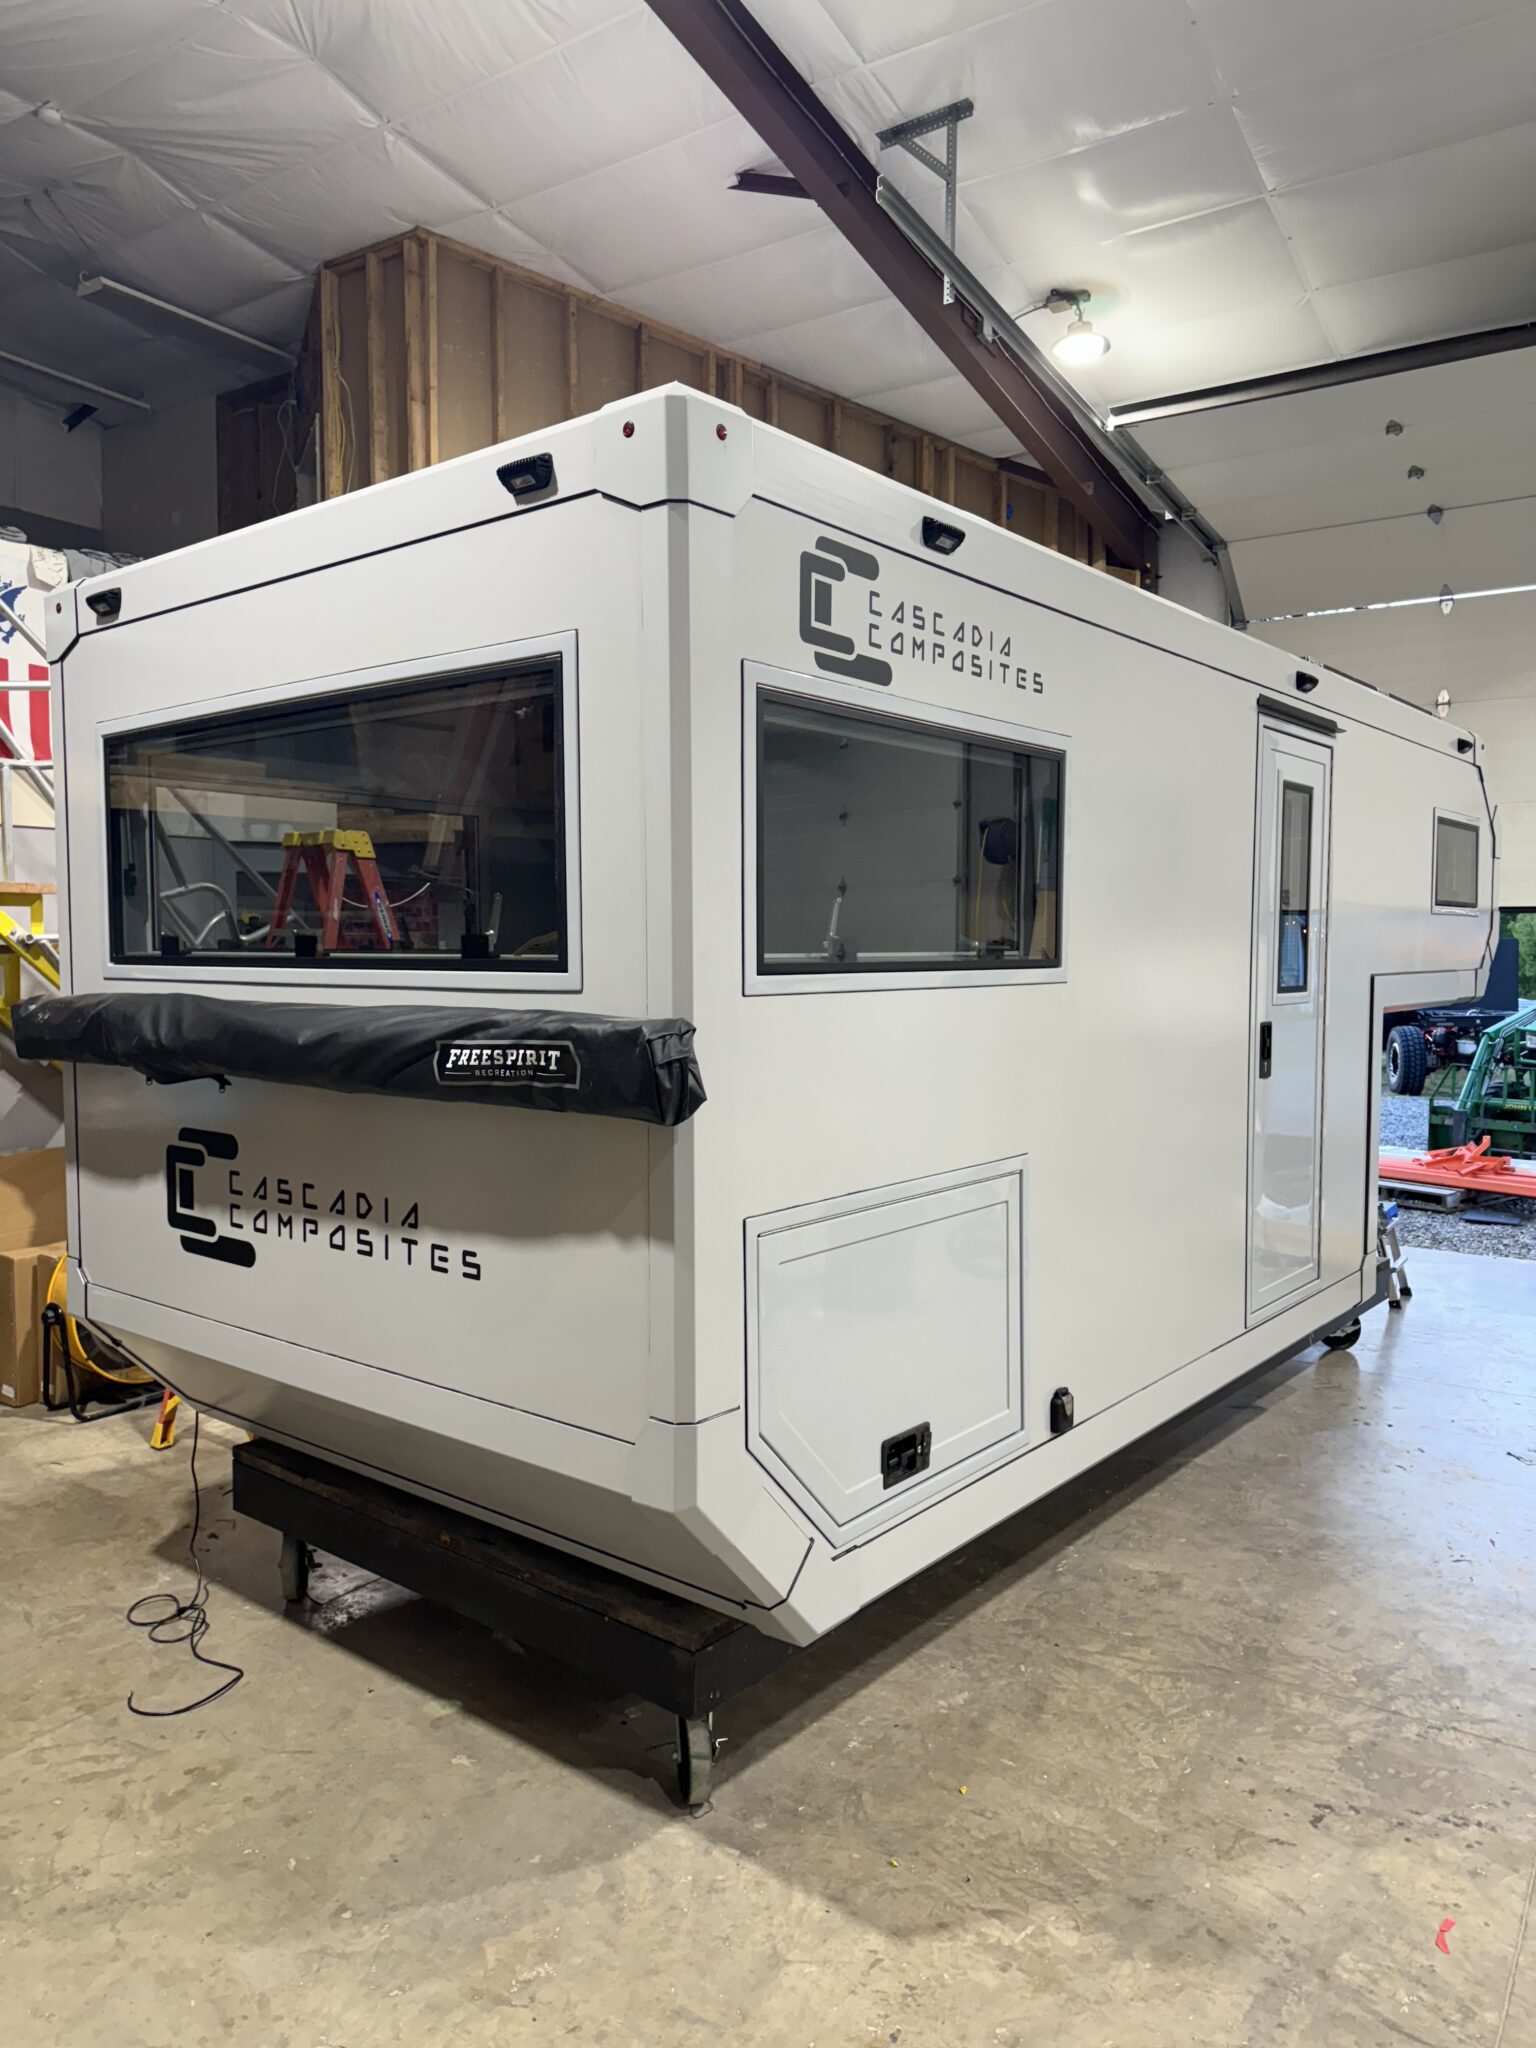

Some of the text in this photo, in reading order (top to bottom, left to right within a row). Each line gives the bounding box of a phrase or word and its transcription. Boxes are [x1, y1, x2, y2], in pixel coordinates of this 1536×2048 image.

[868, 589, 1011, 659] CASCADIA
[868, 623, 1044, 695] COMPOSITES
[445, 1048, 561, 1071] FREESPIRIT
[474, 1069, 534, 1077] RECREATION
[228, 1169, 419, 1230] CASCADIA
[228, 1203, 482, 1282] COMPOSITES
